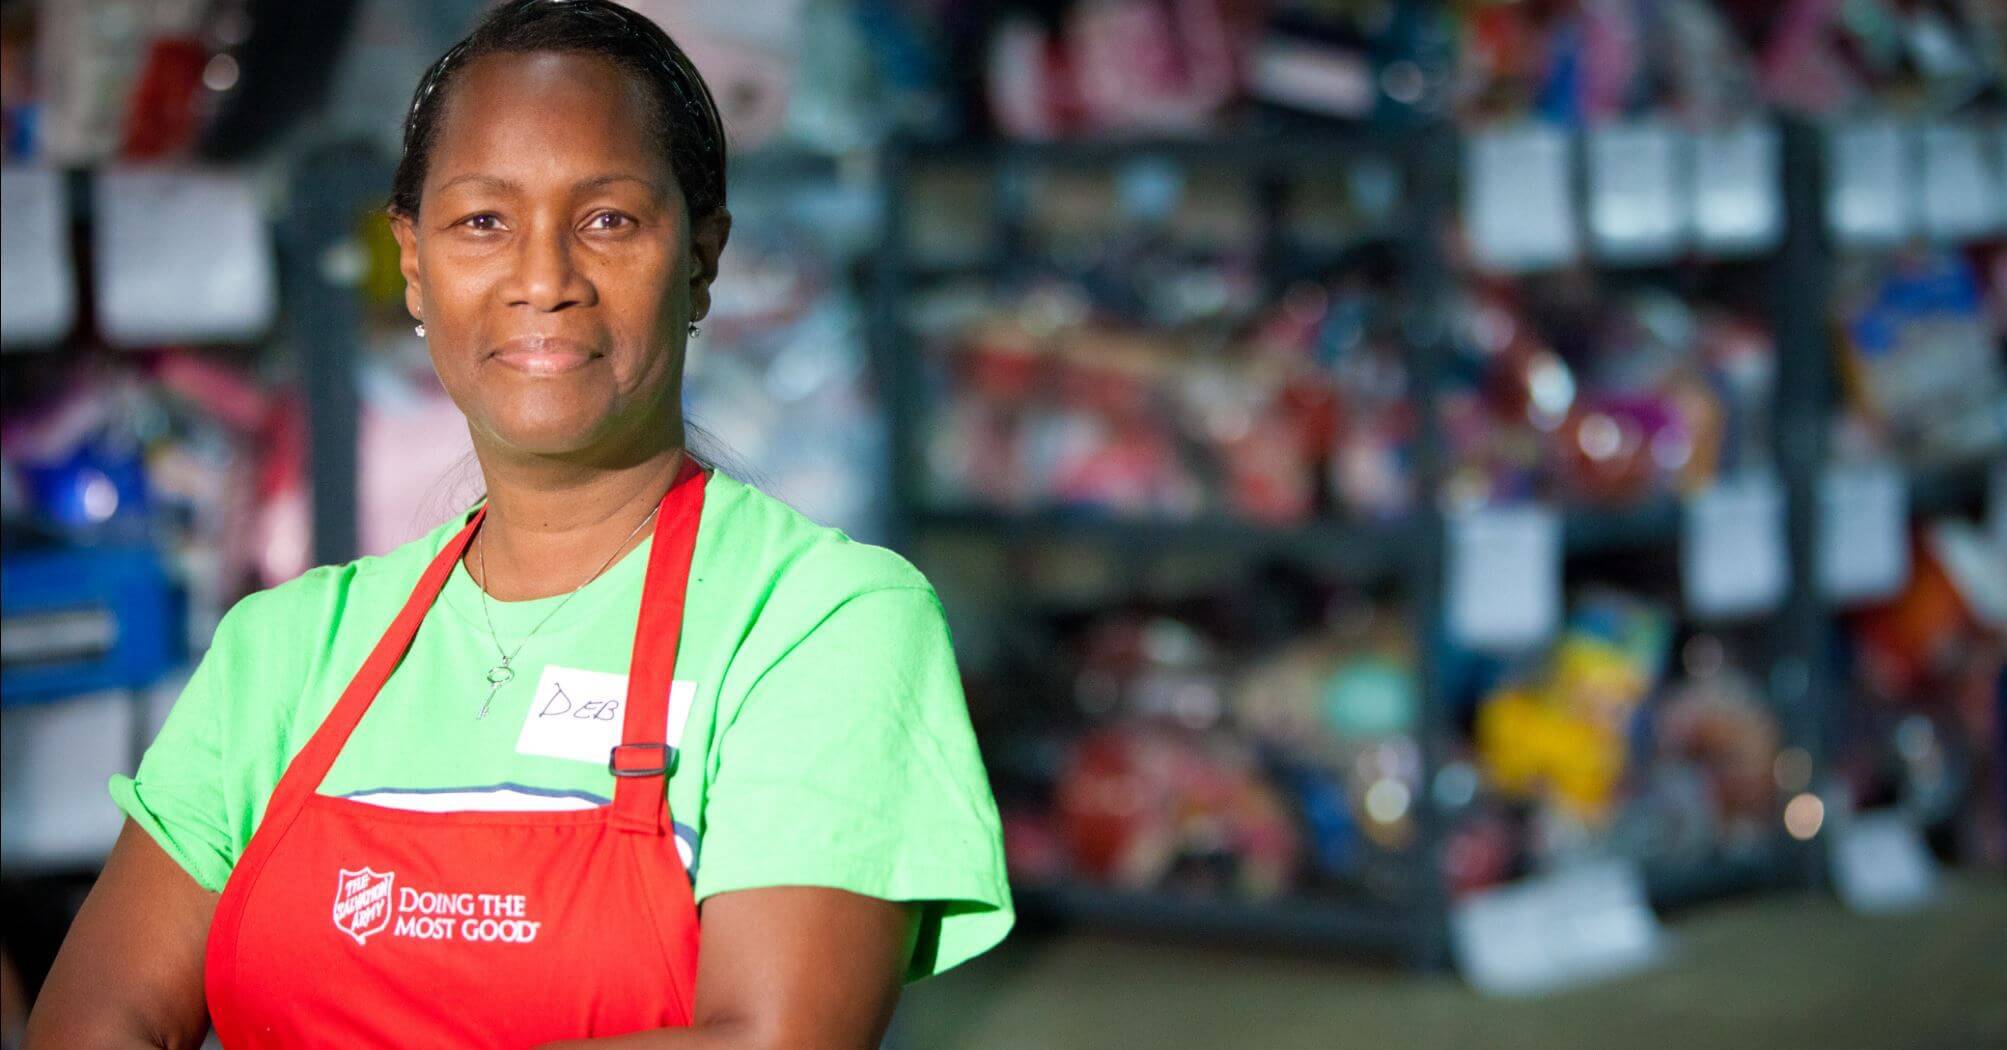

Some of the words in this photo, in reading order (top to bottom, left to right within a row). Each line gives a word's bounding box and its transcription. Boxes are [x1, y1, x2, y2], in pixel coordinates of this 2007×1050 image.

[539, 682, 619, 721] DEB
[345, 873, 369, 893] THE
[336, 878, 390, 920] SALVATION
[398, 887, 475, 916] DOING
[478, 894, 527, 918] THE
[351, 900, 386, 931] ARMY
[393, 916, 456, 940] MOST
[461, 919, 540, 943] GOOD
